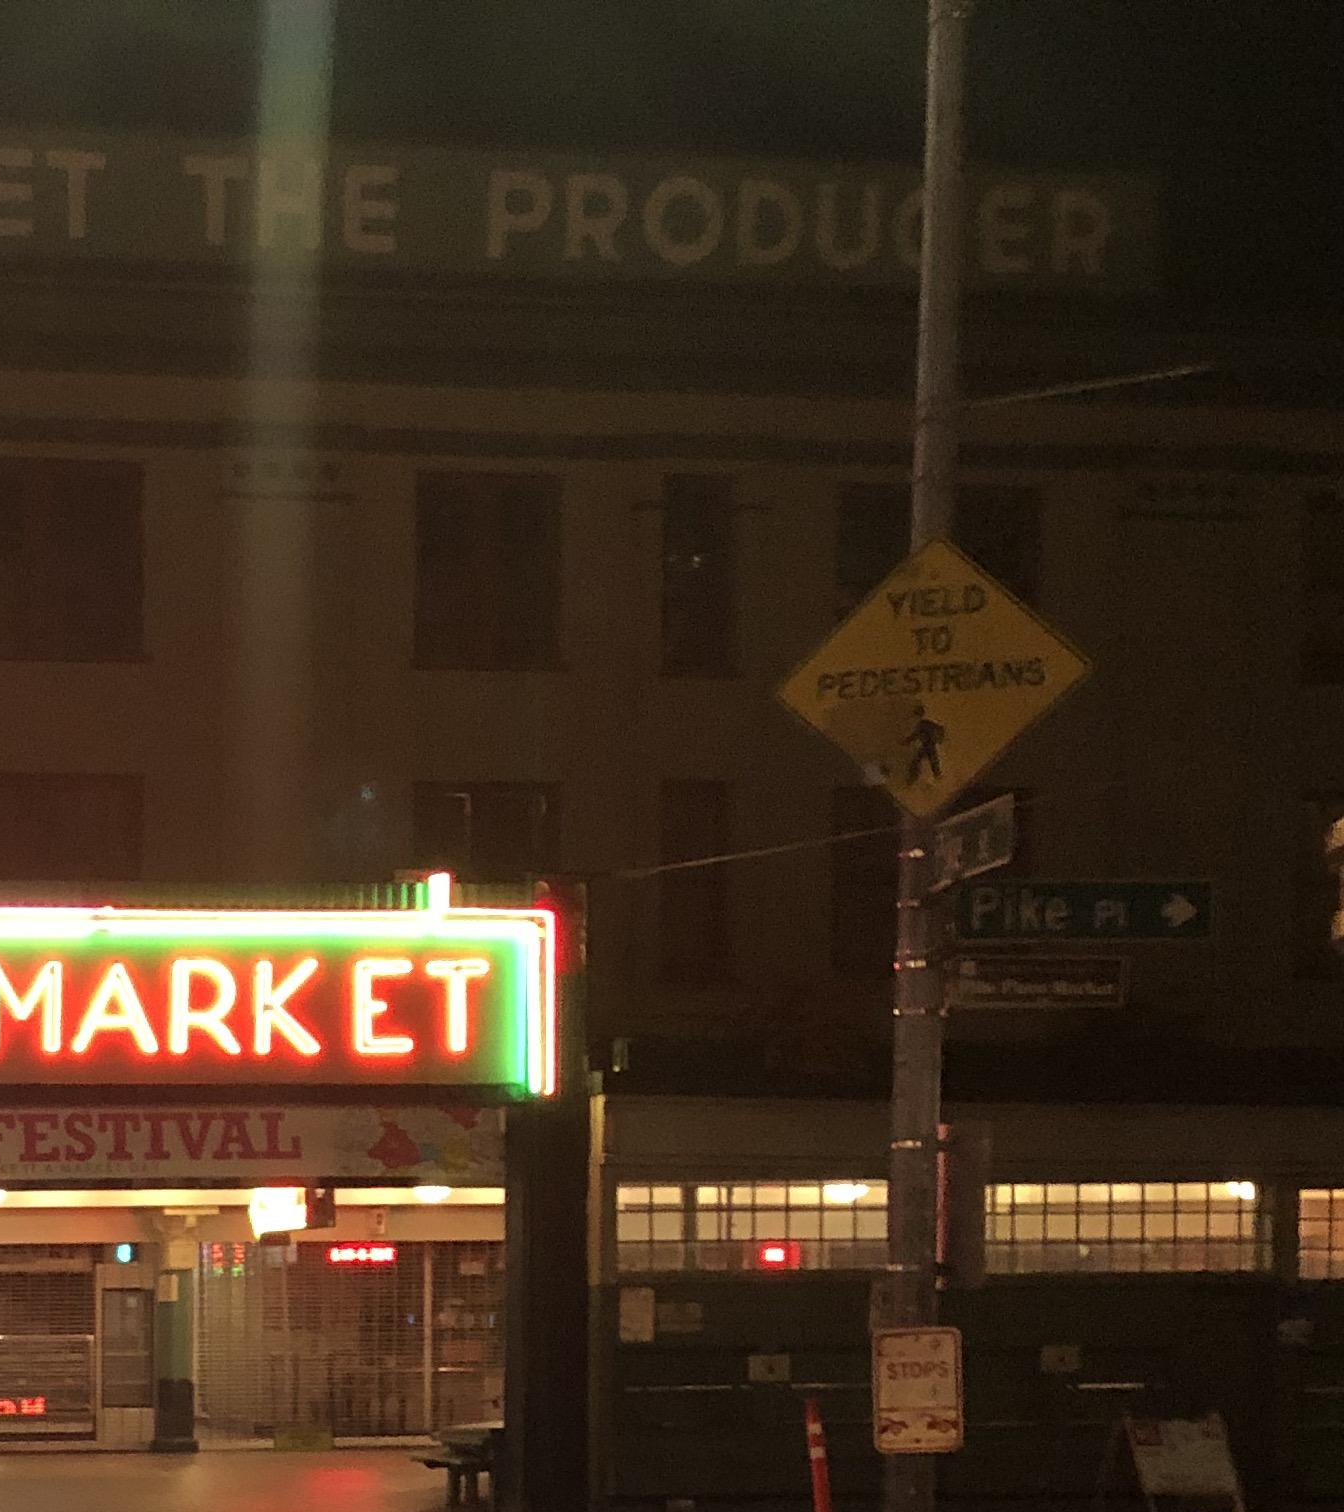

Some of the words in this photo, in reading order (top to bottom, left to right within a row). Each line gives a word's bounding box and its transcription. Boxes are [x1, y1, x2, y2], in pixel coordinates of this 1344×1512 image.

[182, 152, 400, 256] THE
[885, 583, 987, 617] YIELD
[911, 624, 954, 655] TO
[816, 657, 1046, 699] PEDESTRIANS
[970, 887, 1071, 930] Pike
